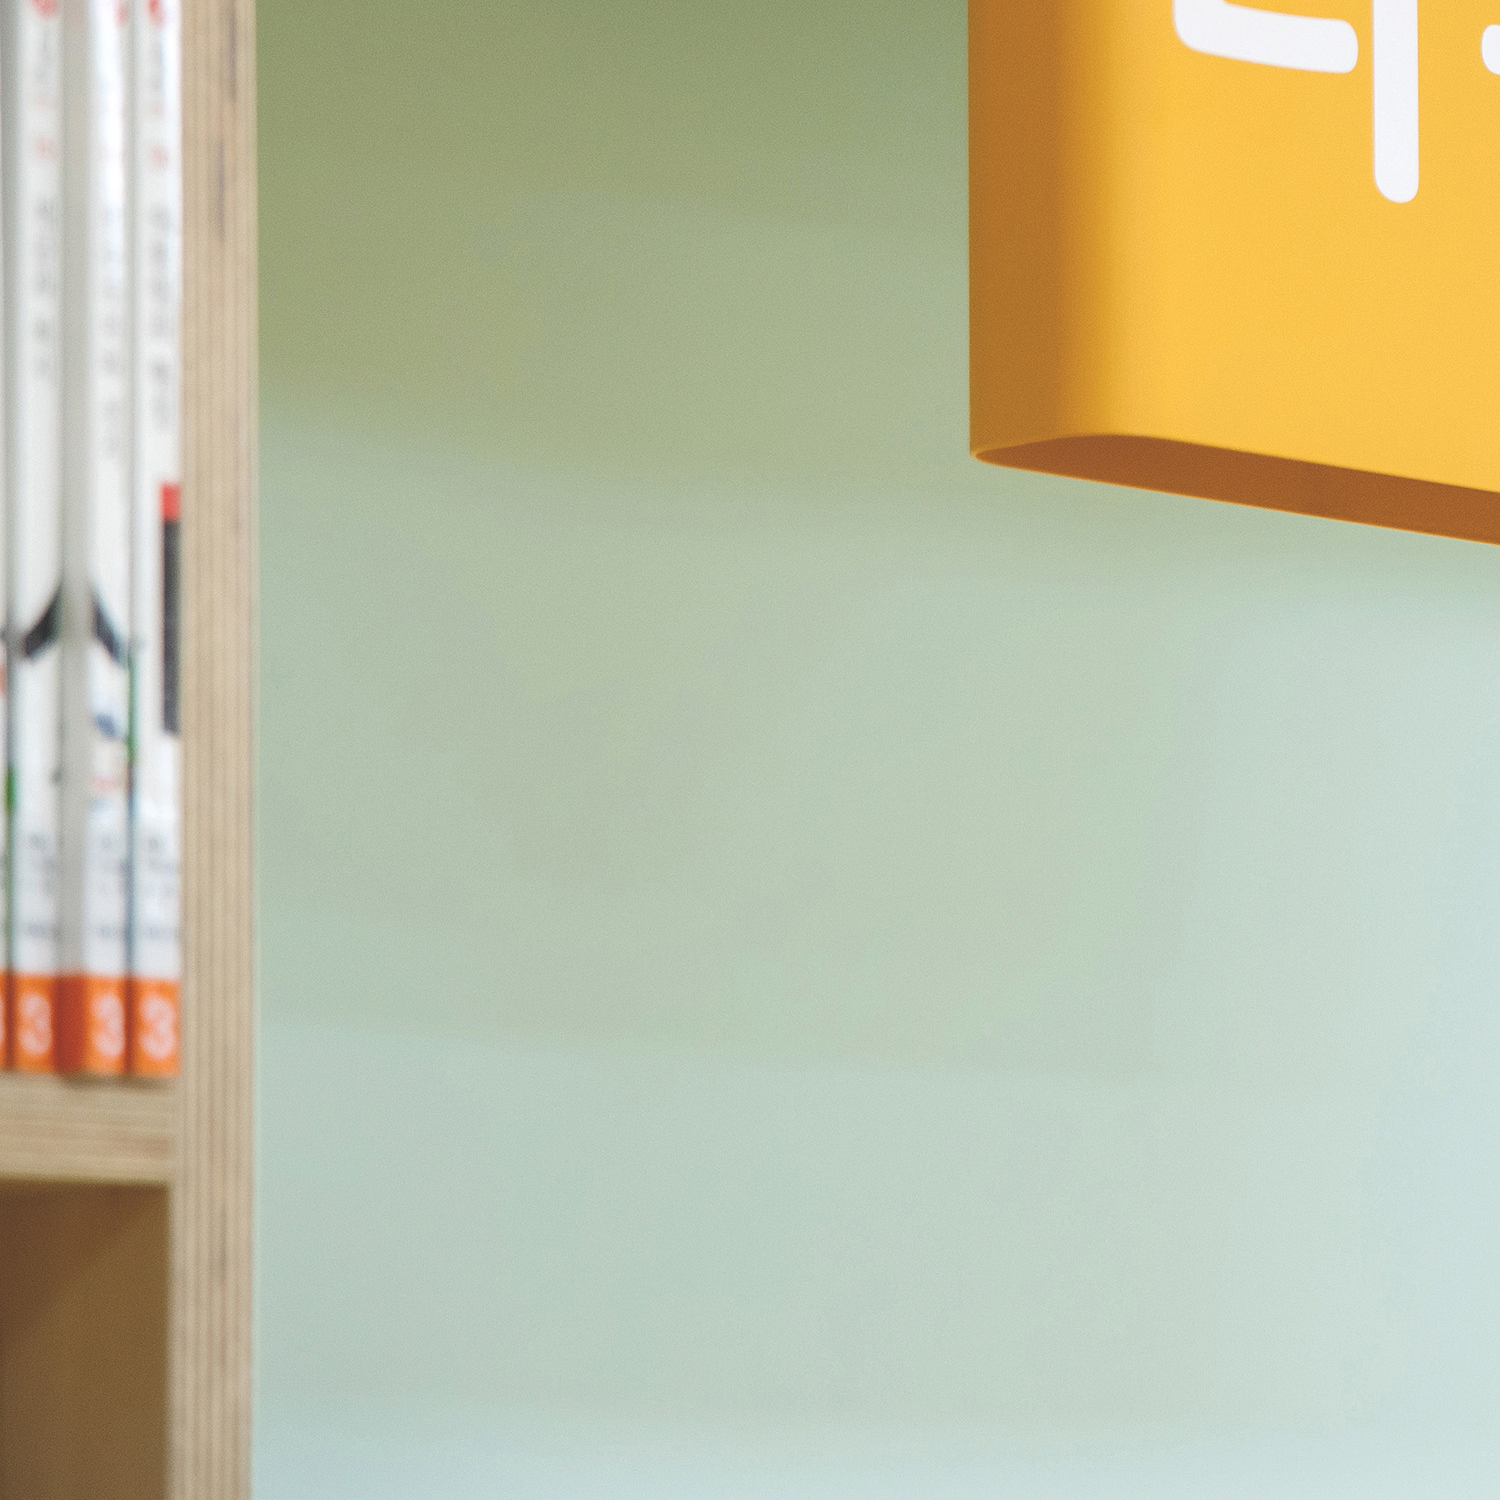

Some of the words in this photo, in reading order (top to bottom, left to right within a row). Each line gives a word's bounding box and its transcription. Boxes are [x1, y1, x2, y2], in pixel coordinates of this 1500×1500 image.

[17, 991, 54, 1056] 3
[91, 993, 126, 1057] 3
[137, 995, 172, 1058] 3
